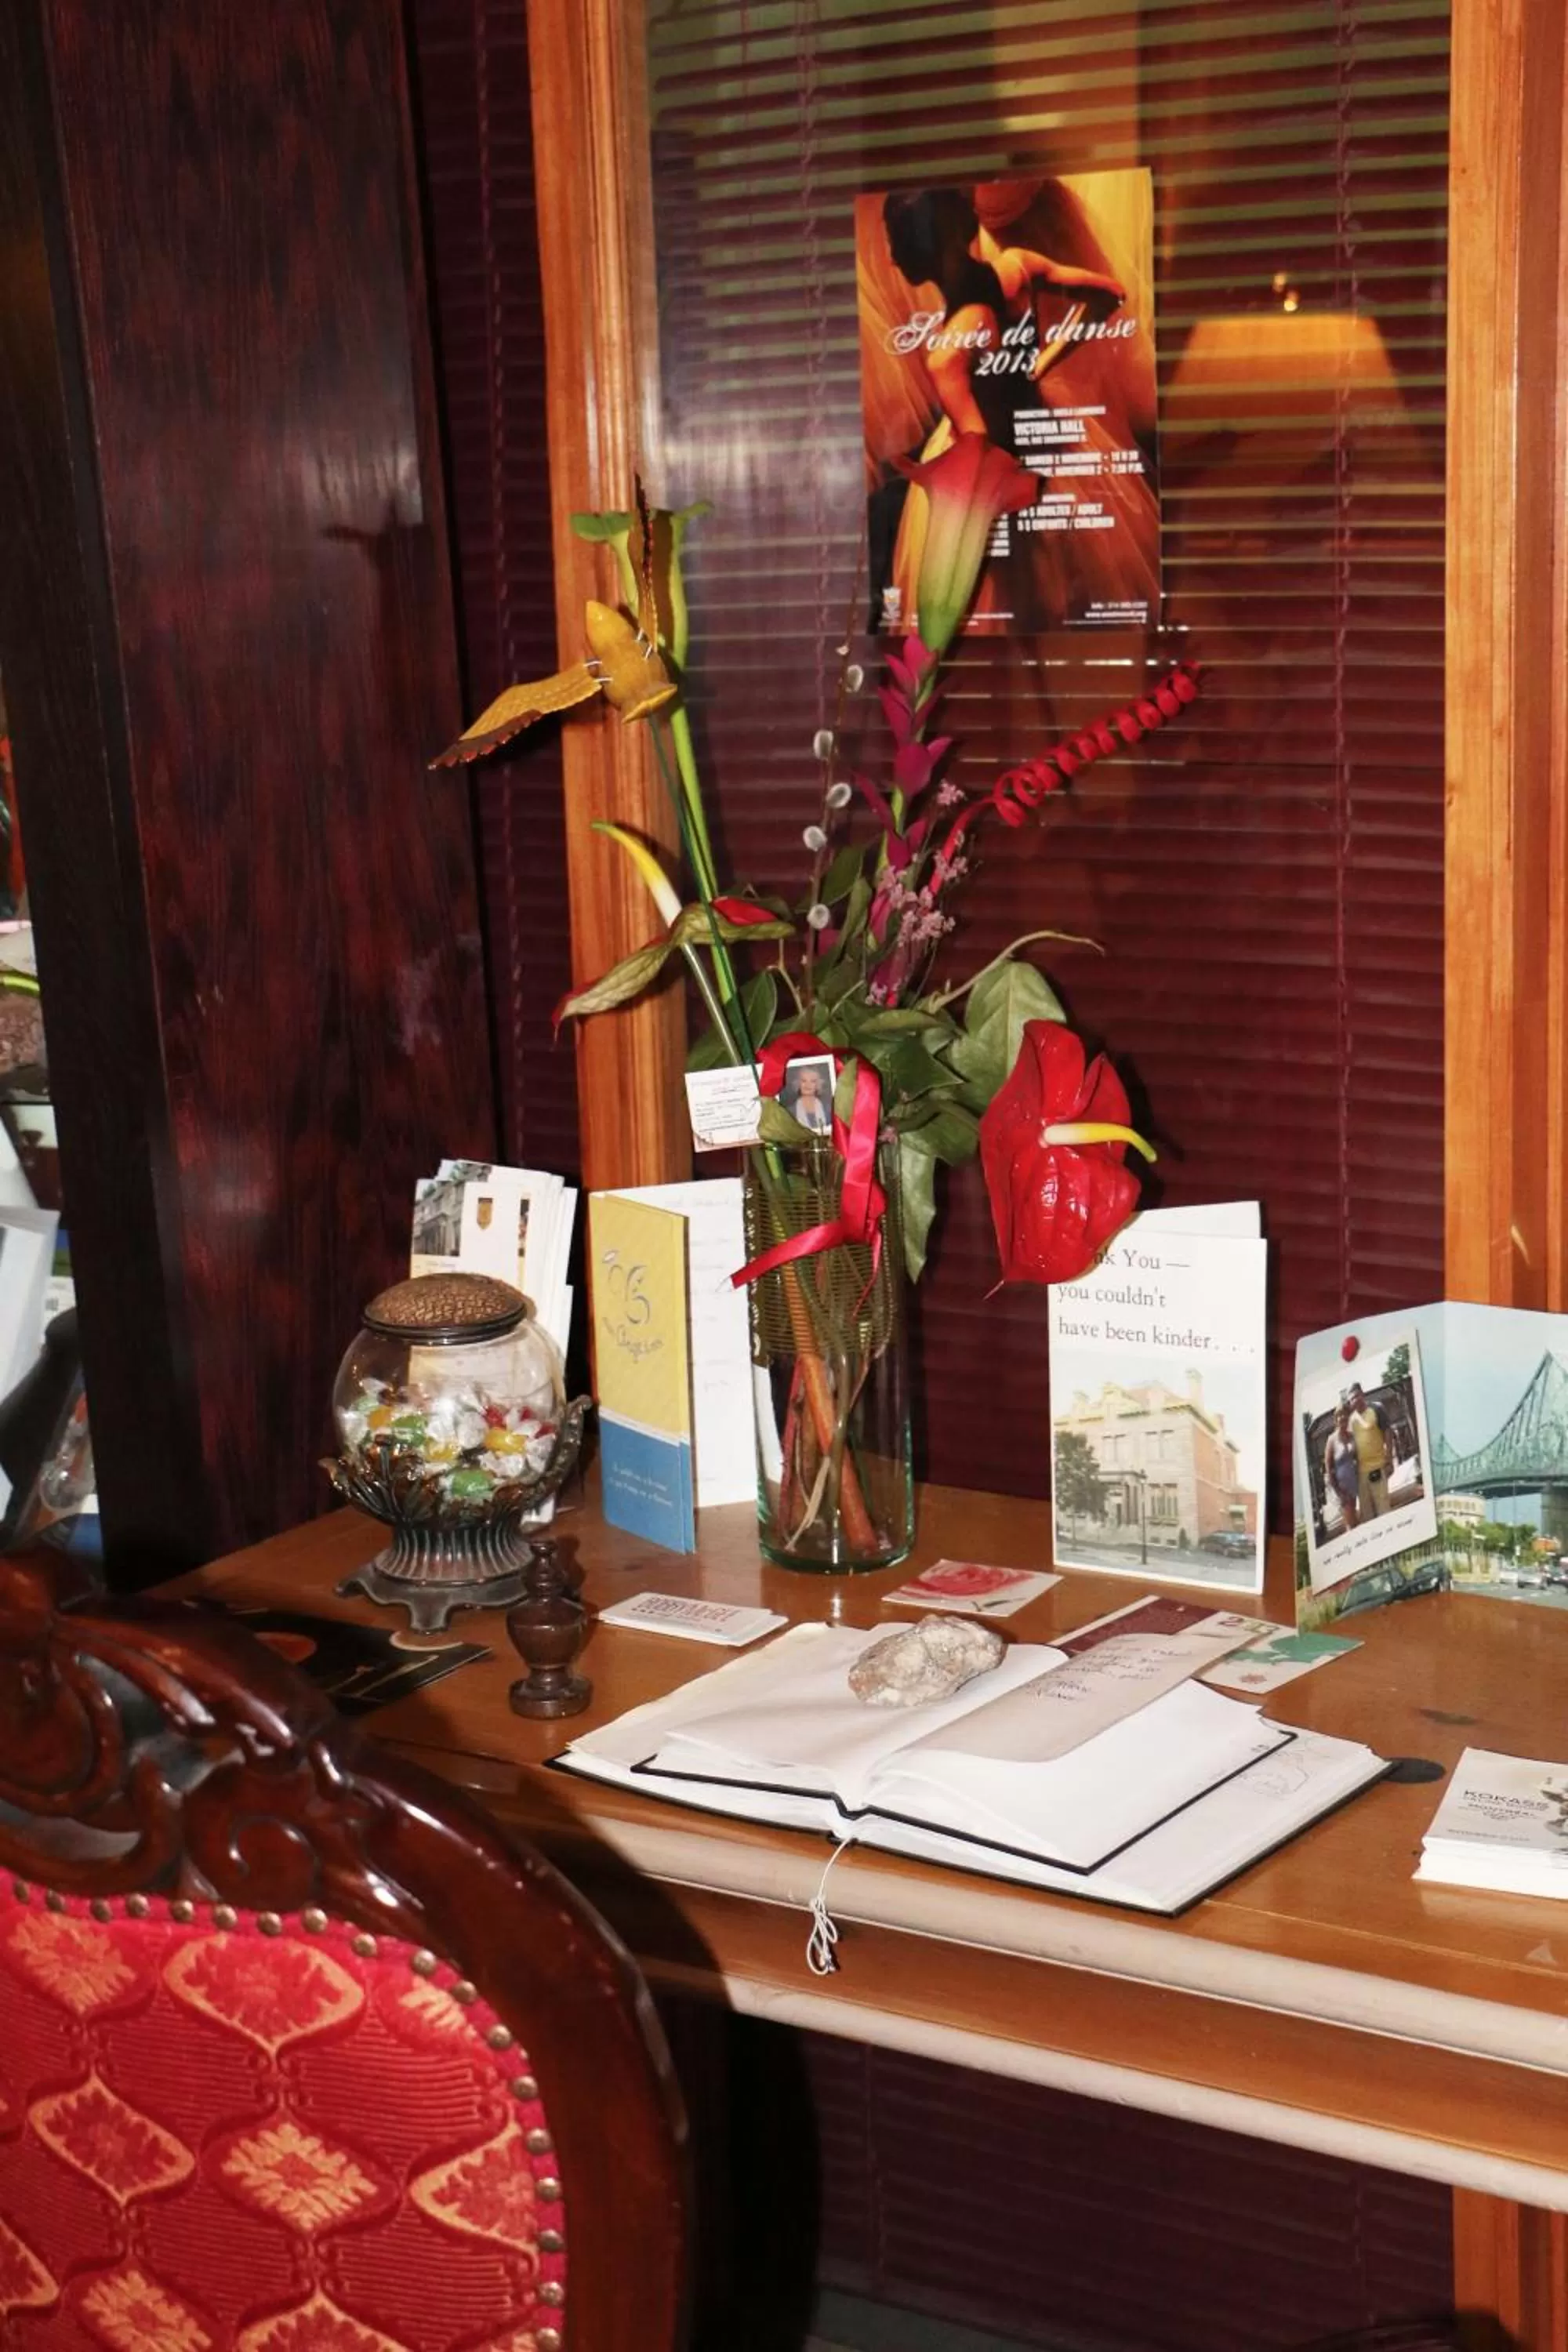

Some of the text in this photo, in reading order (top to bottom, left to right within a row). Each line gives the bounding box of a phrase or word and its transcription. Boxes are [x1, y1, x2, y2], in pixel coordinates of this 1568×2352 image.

[891, 303, 1137, 354] Soirée de danse
[975, 349, 1040, 376] 2013
[1123, 1248, 1160, 1269] You
[1058, 1285, 1167, 1308] you couldn't
[1058, 1316, 1099, 1338] have
[1105, 1321, 1145, 1344] been
